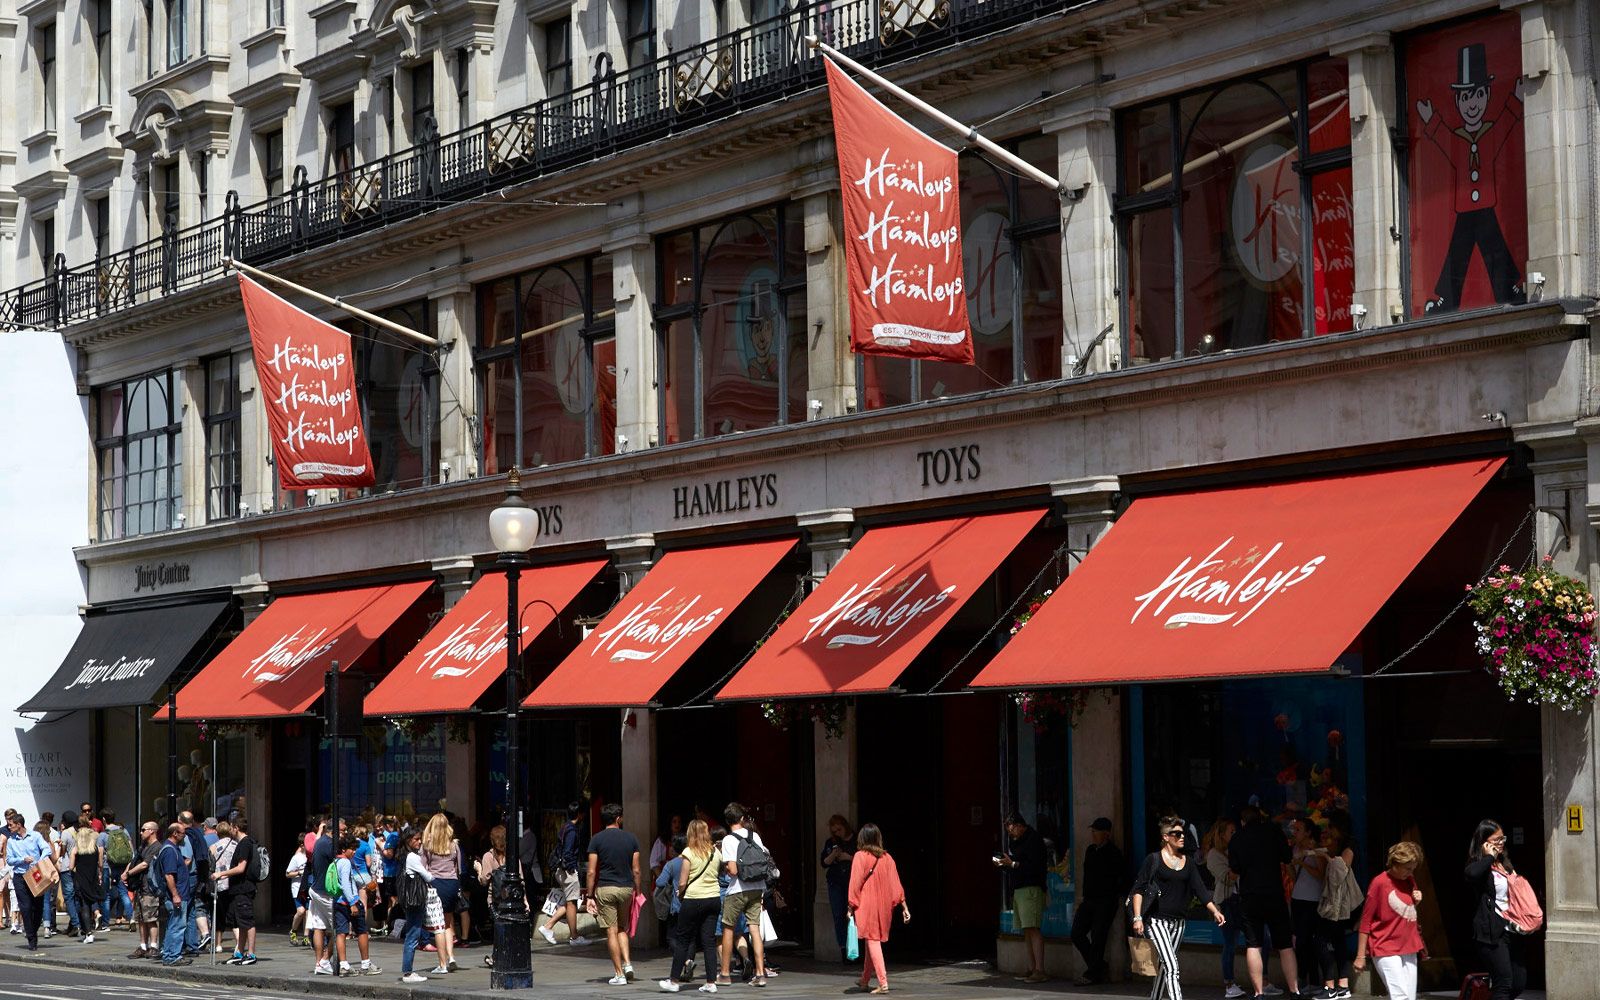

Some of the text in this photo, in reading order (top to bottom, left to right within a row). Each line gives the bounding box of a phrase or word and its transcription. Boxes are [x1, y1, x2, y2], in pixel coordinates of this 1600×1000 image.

[855, 147, 952, 212] Hamleys
[859, 200, 958, 264] Hamleys
[863, 253, 962, 316] Hamleys
[904, 329, 932, 339] LONDON
[267, 336, 345, 380] Hamleys
[275, 373, 351, 417] Hamleys
[281, 411, 359, 455] Hamleys
[917, 444, 981, 487] TOYS
[673, 473, 777, 519] HAMLEYS
[134, 562, 190, 592] Juicy Couture
[1130, 536, 1326, 627] Hamleys
[591, 586, 723, 664] Hamleys
[803, 564, 956, 648] Hamleys
[64, 656, 155, 690] Juicy Couture
[242, 624, 338, 683] Hamleys
[4, 767, 72, 778] WEITZMAN
[15, 752, 61, 763] STUART
[1569, 807, 1581, 829] H
